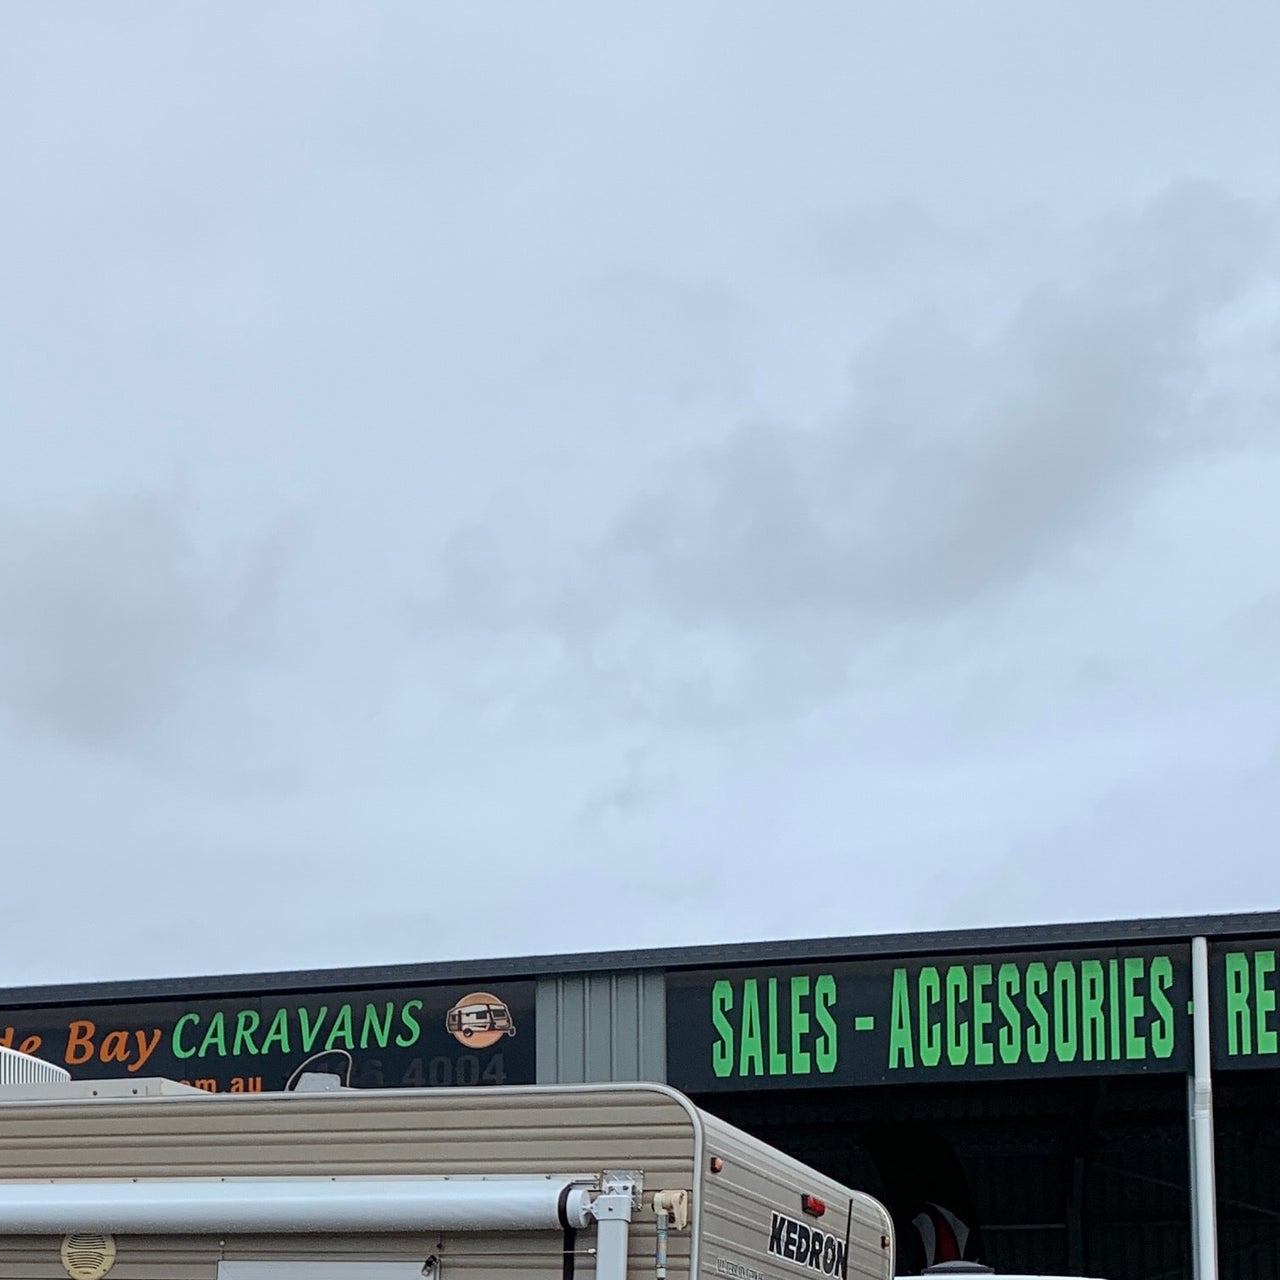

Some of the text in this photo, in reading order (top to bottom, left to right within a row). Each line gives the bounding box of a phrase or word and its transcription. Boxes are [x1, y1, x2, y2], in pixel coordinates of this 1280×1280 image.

[65, 1020, 162, 1072] Bay
[172, 1000, 423, 1059] CARAVANS
[712, 974, 837, 1078] SALES
[888, 956, 1175, 1069] ACCESSORIES
[1225, 951, 1278, 1055] RE
[768, 1211, 847, 1280] KEDRON
